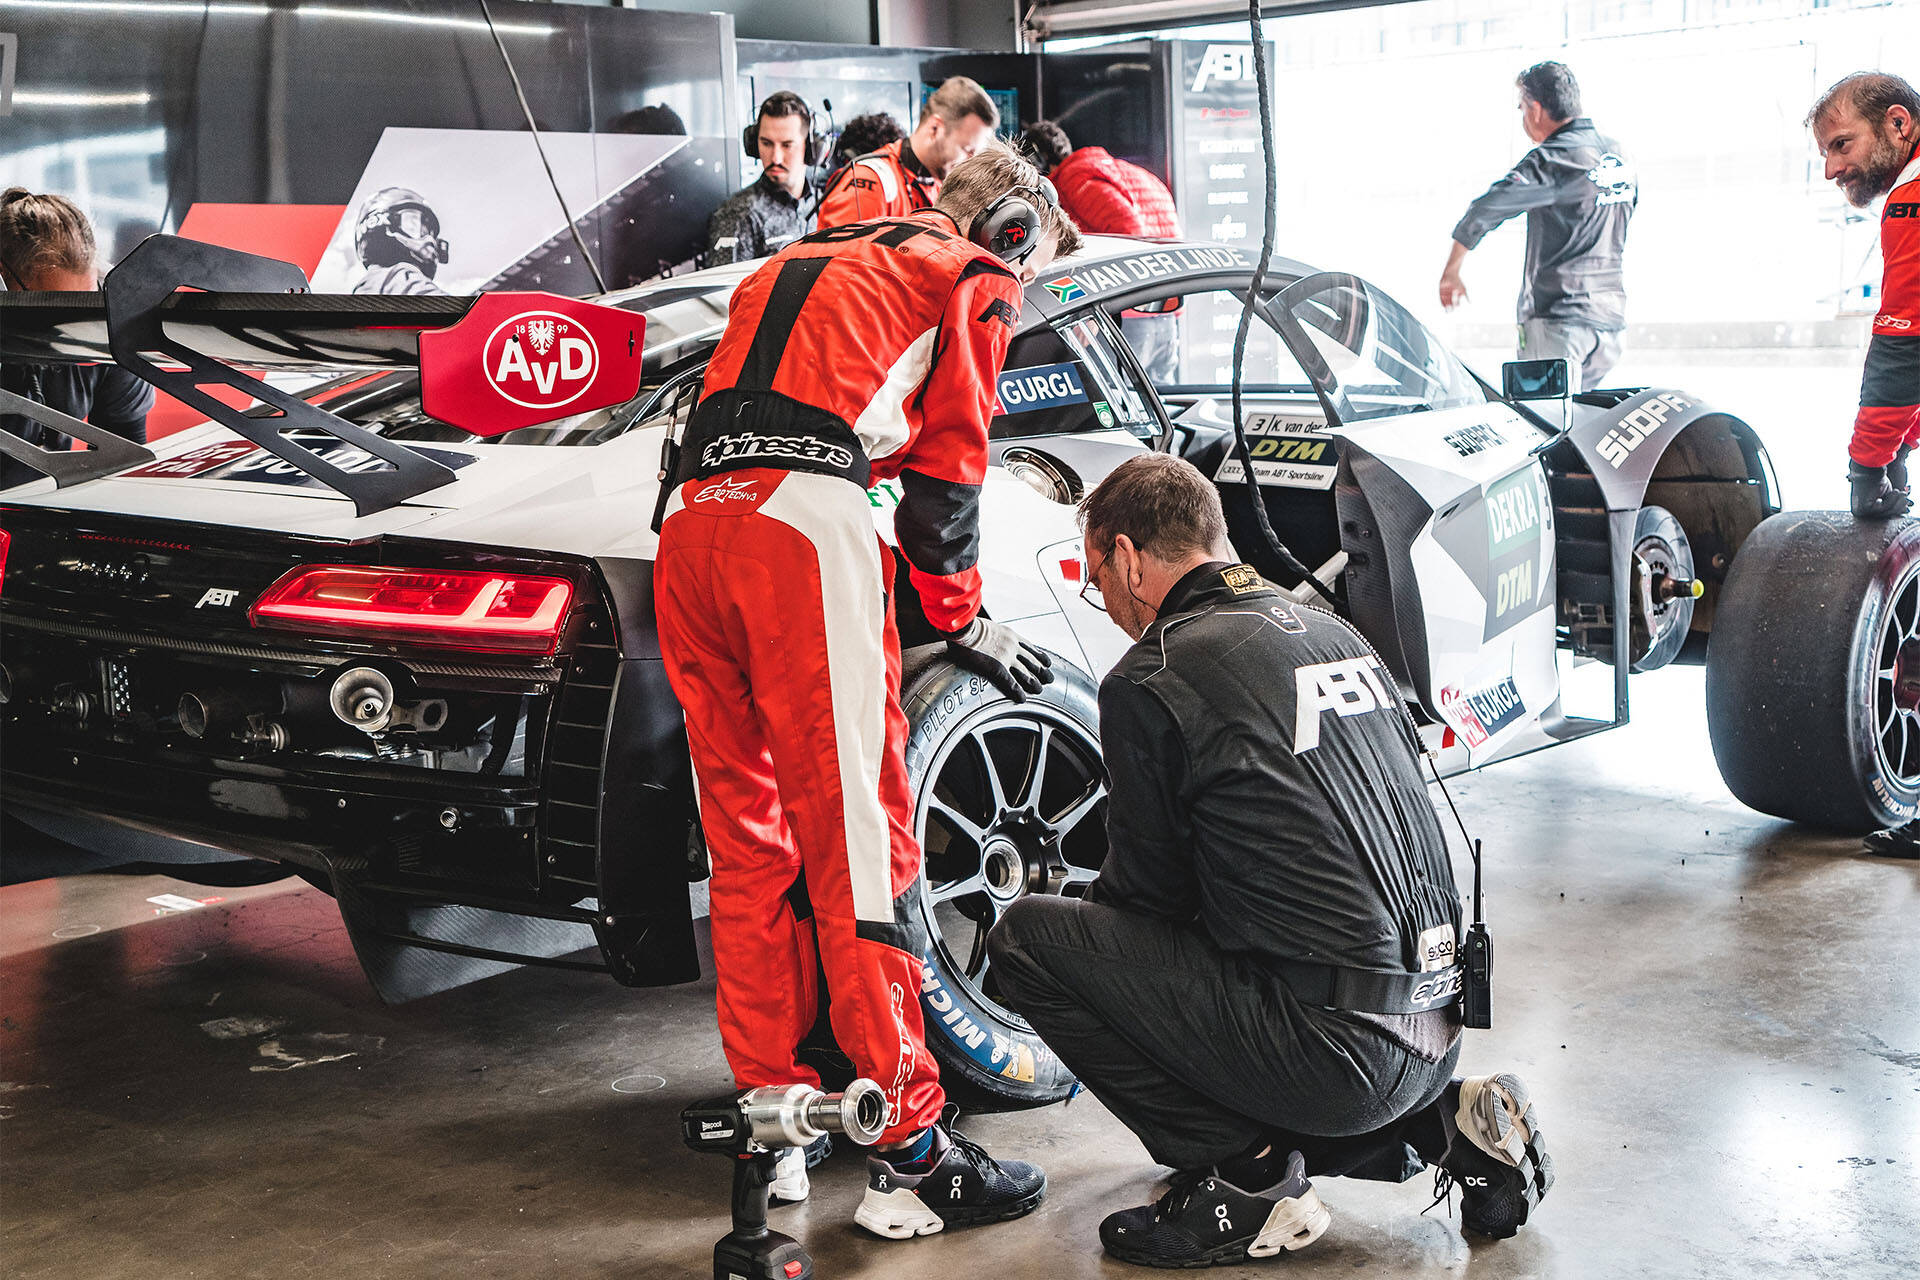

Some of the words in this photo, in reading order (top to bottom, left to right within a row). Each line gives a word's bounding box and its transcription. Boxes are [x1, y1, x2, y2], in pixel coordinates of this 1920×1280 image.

[1191, 44, 1255, 92] ABT
[843, 178, 877, 192] ABT
[1073, 258, 1132, 294] VAN
[1125, 252, 1182, 280] DER
[1175, 248, 1250, 270] LINDE
[515, 324, 526, 334] 18
[557, 324, 568, 334] 99
[977, 298, 1019, 327] AB
[1001, 372, 1083, 405] GURGL
[1252, 418, 1266, 431] 3
[1285, 423, 1301, 433] van
[701, 432, 853, 468] alpinestars
[1250, 439, 1326, 460] DTM
[1271, 468, 1286, 478] ABT
[1287, 470, 1324, 482] Sportsline
[1486, 482, 1539, 544] DEKRA
[195, 588, 239, 609] ABT
[1496, 559, 1532, 618] DTM
[921, 685, 964, 742] PILOT
[969, 675, 989, 696] SP
[1294, 654, 1391, 755] ABT
[1872, 777, 1916, 818] MICHELIN
[920, 965, 987, 1050] MICH
